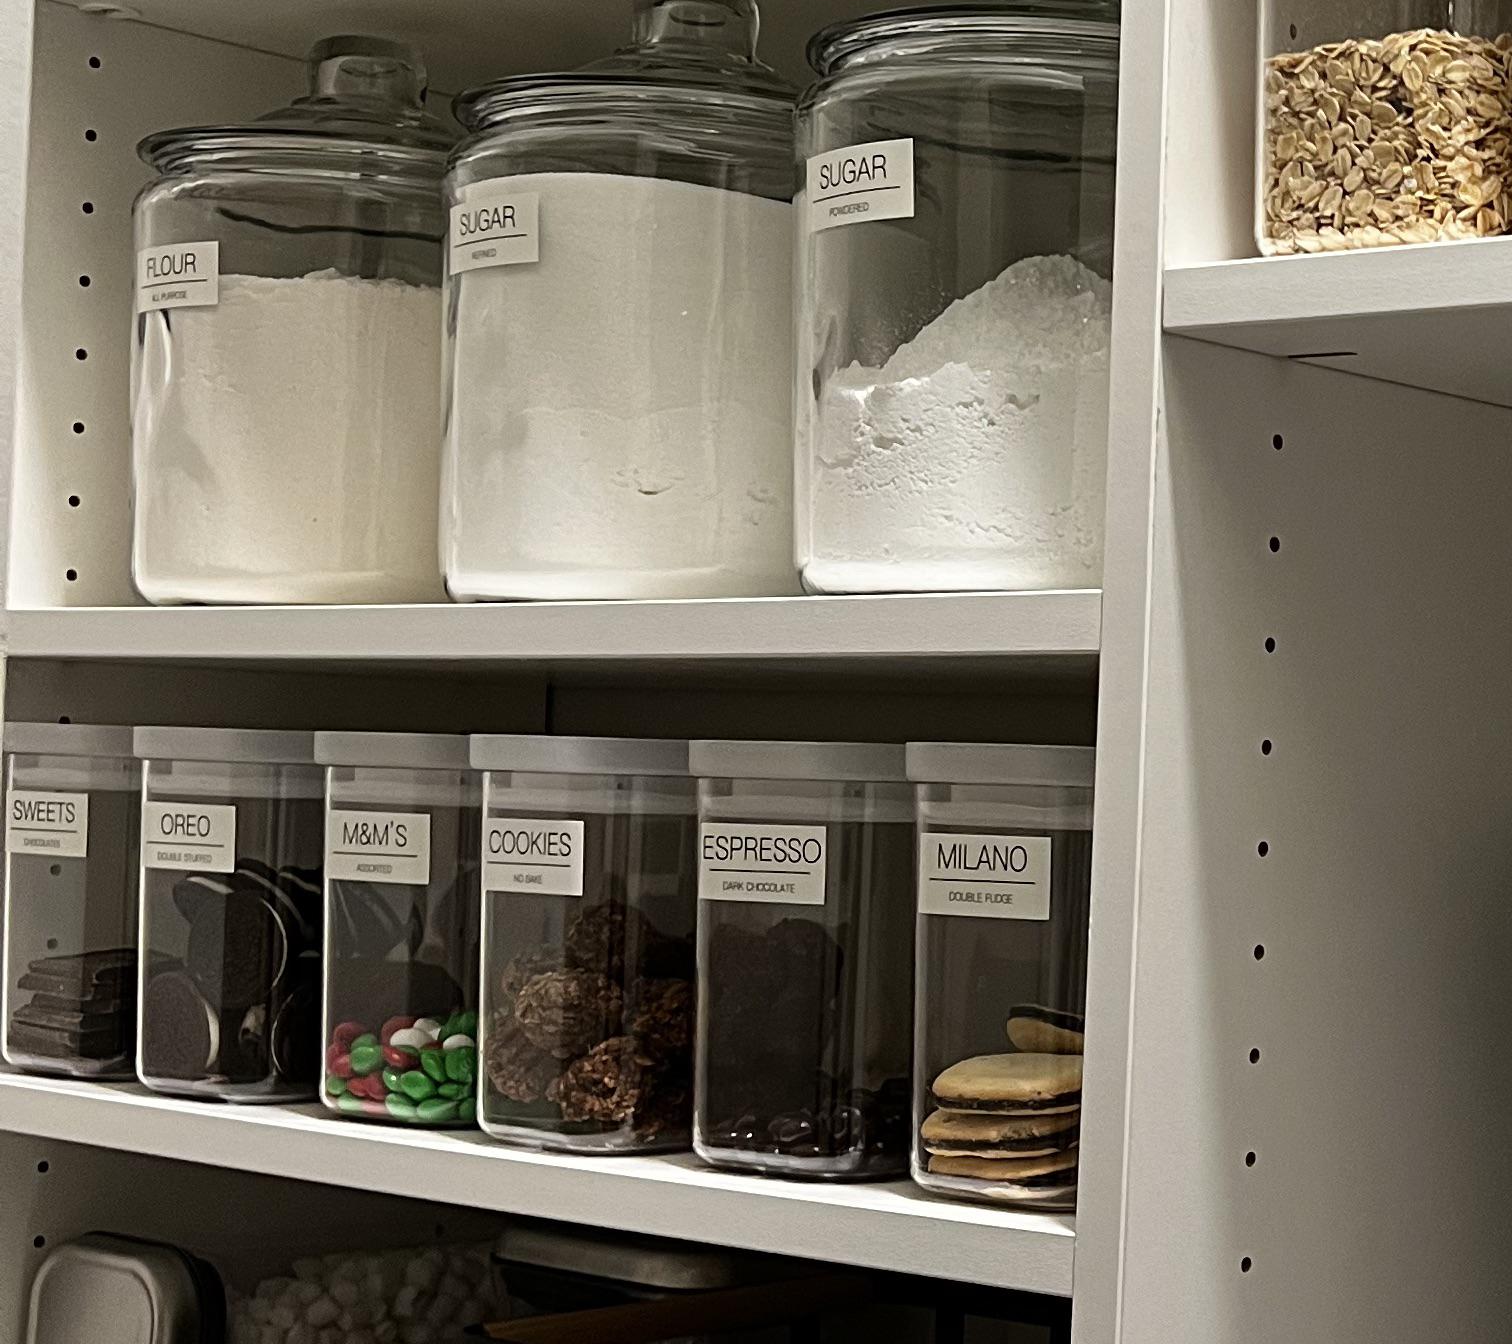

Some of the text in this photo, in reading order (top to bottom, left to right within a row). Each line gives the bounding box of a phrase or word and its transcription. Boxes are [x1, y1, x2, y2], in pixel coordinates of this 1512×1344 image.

[819, 154, 887, 190] SUGAR
[459, 205, 517, 236] SUGAR
[146, 253, 197, 278] FLOUR
[13, 799, 76, 823] SWEETS
[161, 813, 211, 837] OREO
[342, 820, 408, 847] M&M'S
[488, 830, 572, 857] COOKIES
[703, 835, 822, 864] ESPRESSO
[938, 842, 1028, 872] MILANO
[722, 881, 796, 894] DARK CHOCOLATE
[949, 891, 1014, 904] DOUBLE FUDGE
